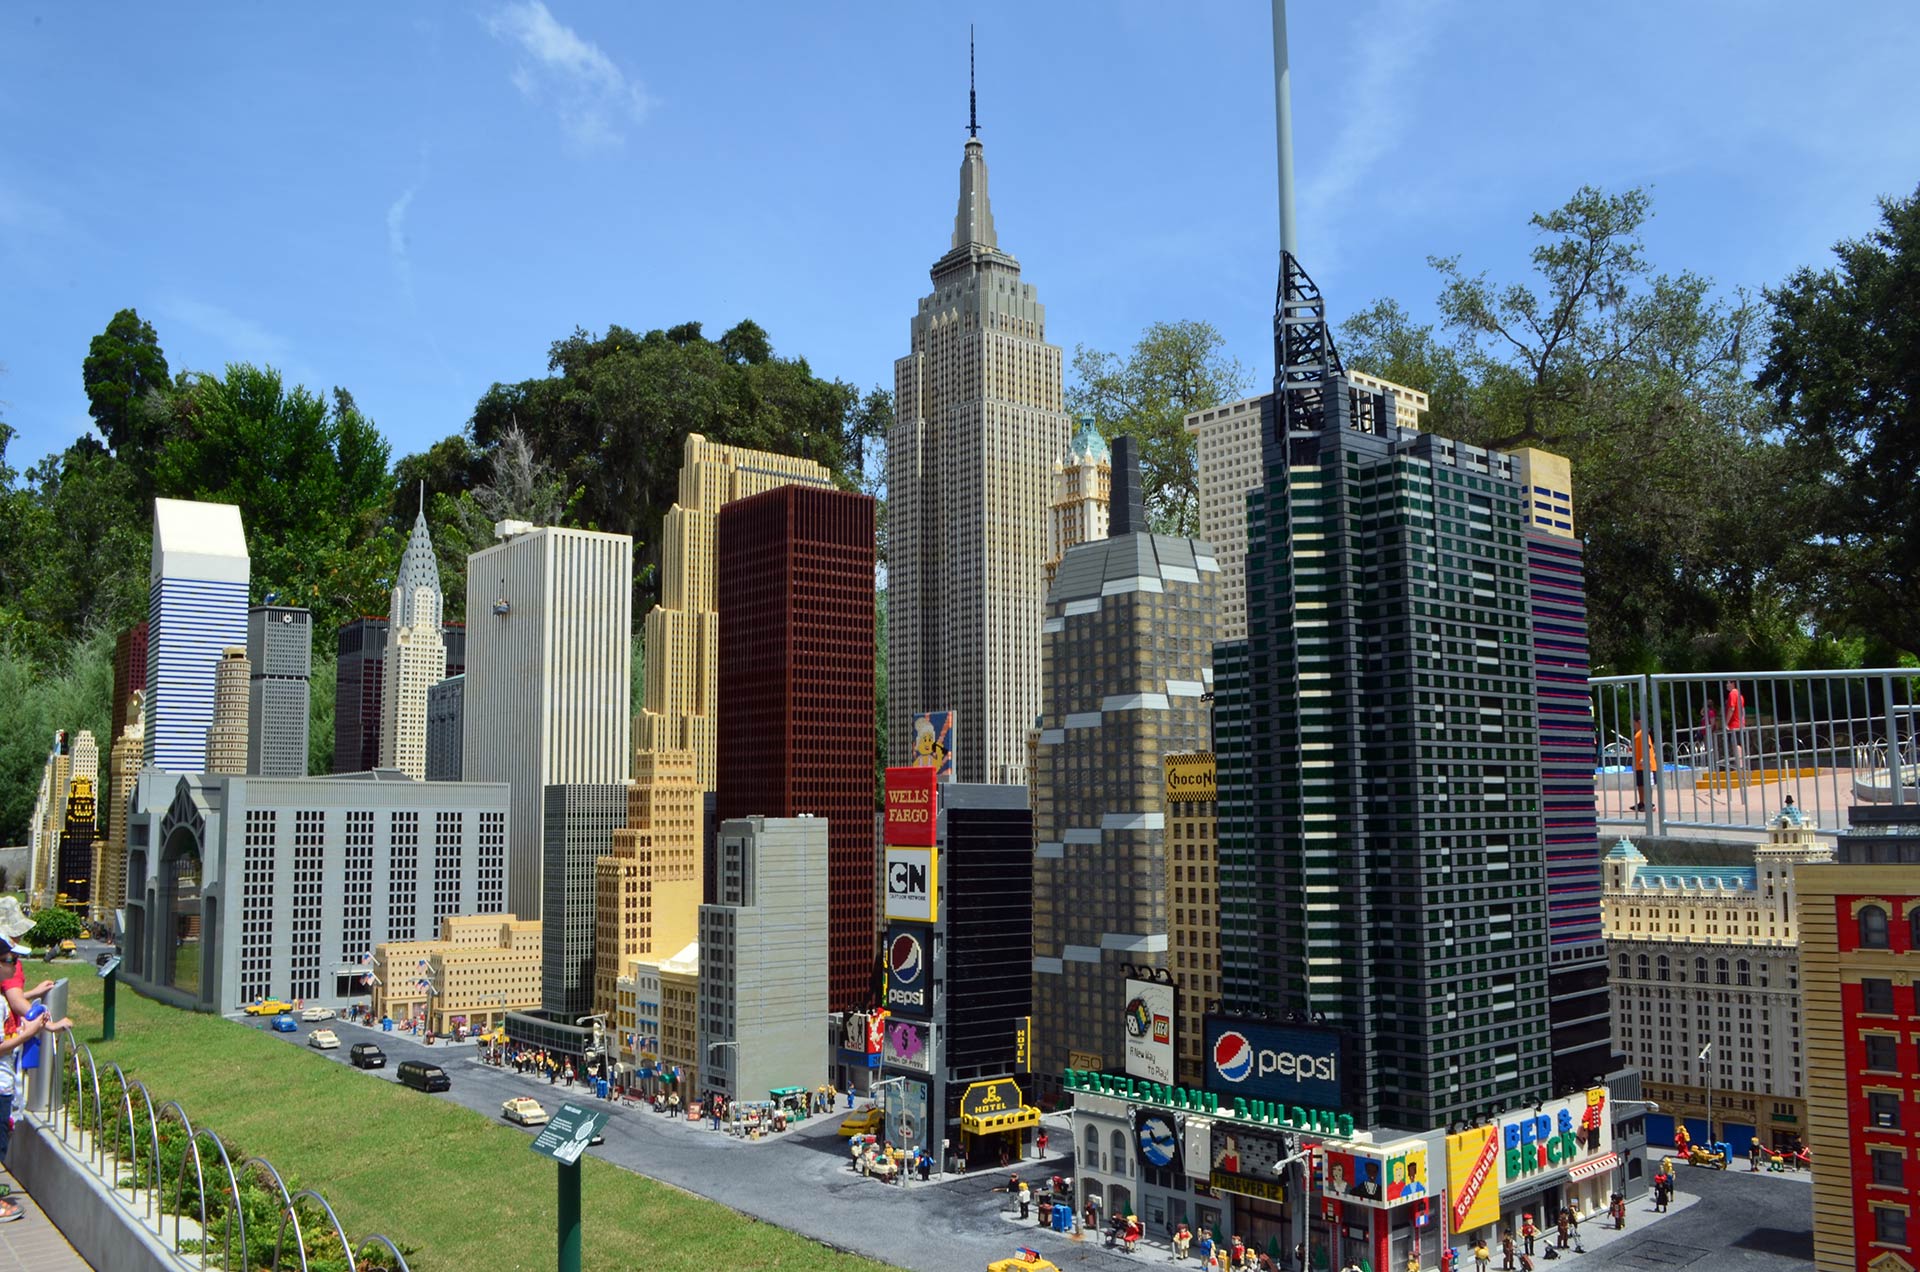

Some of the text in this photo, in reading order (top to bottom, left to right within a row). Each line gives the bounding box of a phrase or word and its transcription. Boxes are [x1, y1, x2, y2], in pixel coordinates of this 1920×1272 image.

[888, 789, 929, 804] WELLS
[889, 809, 928, 823] FARGO
[889, 862, 926, 894] CN
[889, 989, 924, 1006] pepsi
[1017, 1030, 1025, 1064] HOTEL
[1070, 1053, 1102, 1070] 750
[1258, 1049, 1336, 1082] pepsi
[975, 1103, 1007, 1114] HOTEL
[1234, 1096, 1354, 1137] BUILDING
[1504, 1108, 1573, 1151] BED &
